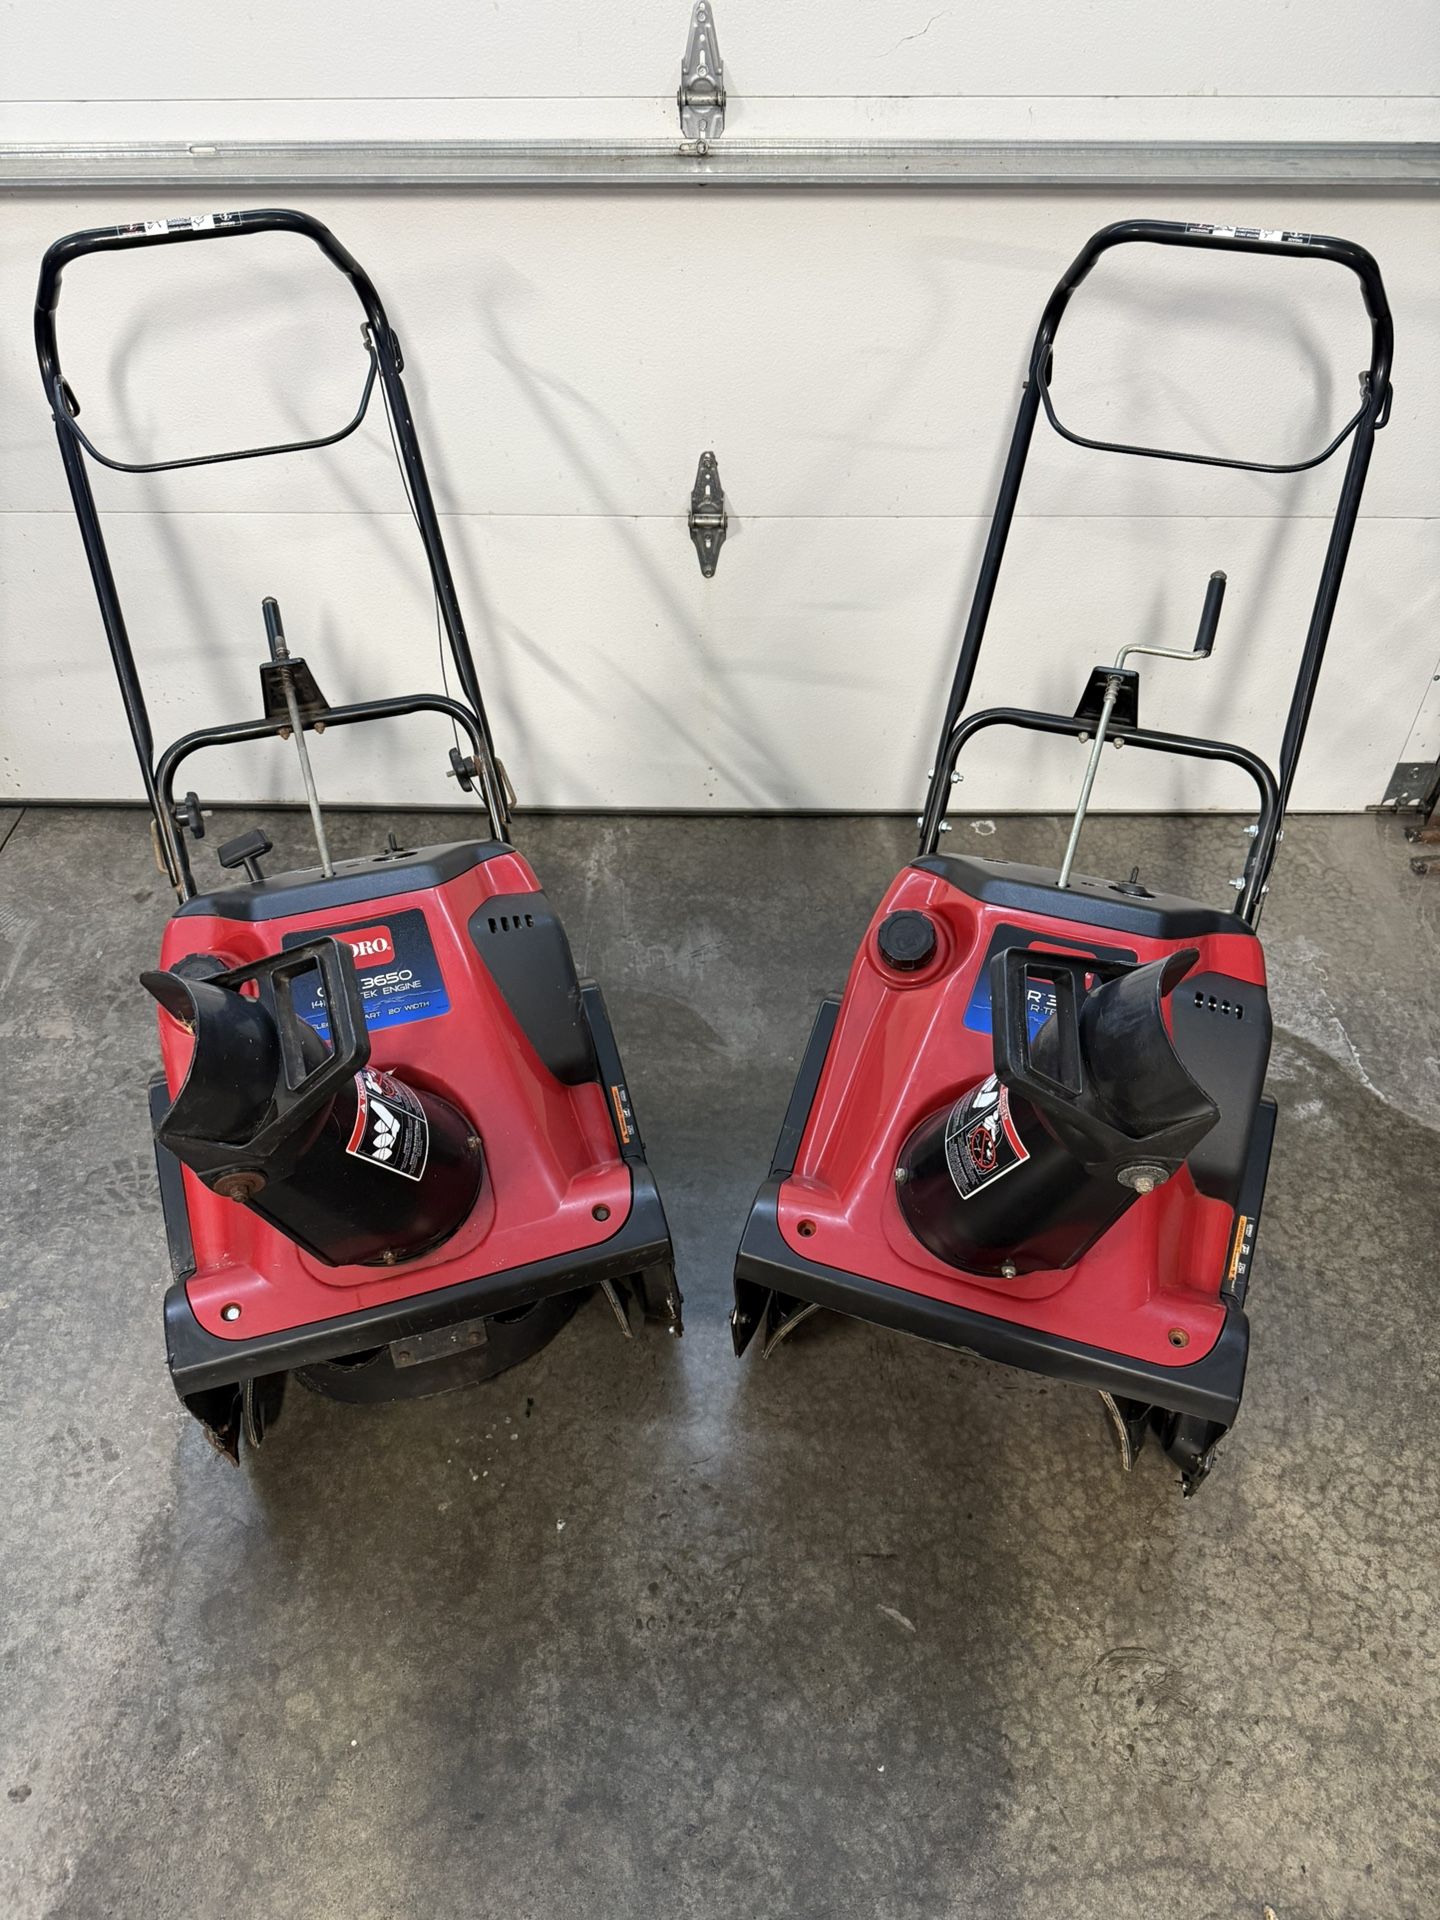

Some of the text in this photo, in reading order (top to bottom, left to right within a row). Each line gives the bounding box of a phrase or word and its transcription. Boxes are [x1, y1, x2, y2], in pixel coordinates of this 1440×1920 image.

[360, 969, 413, 990] 3650
[382, 980, 422, 995] ENGINE
[404, 1000, 430, 1011] WIDTH
[1030, 1003, 1057, 1016] R-TE
